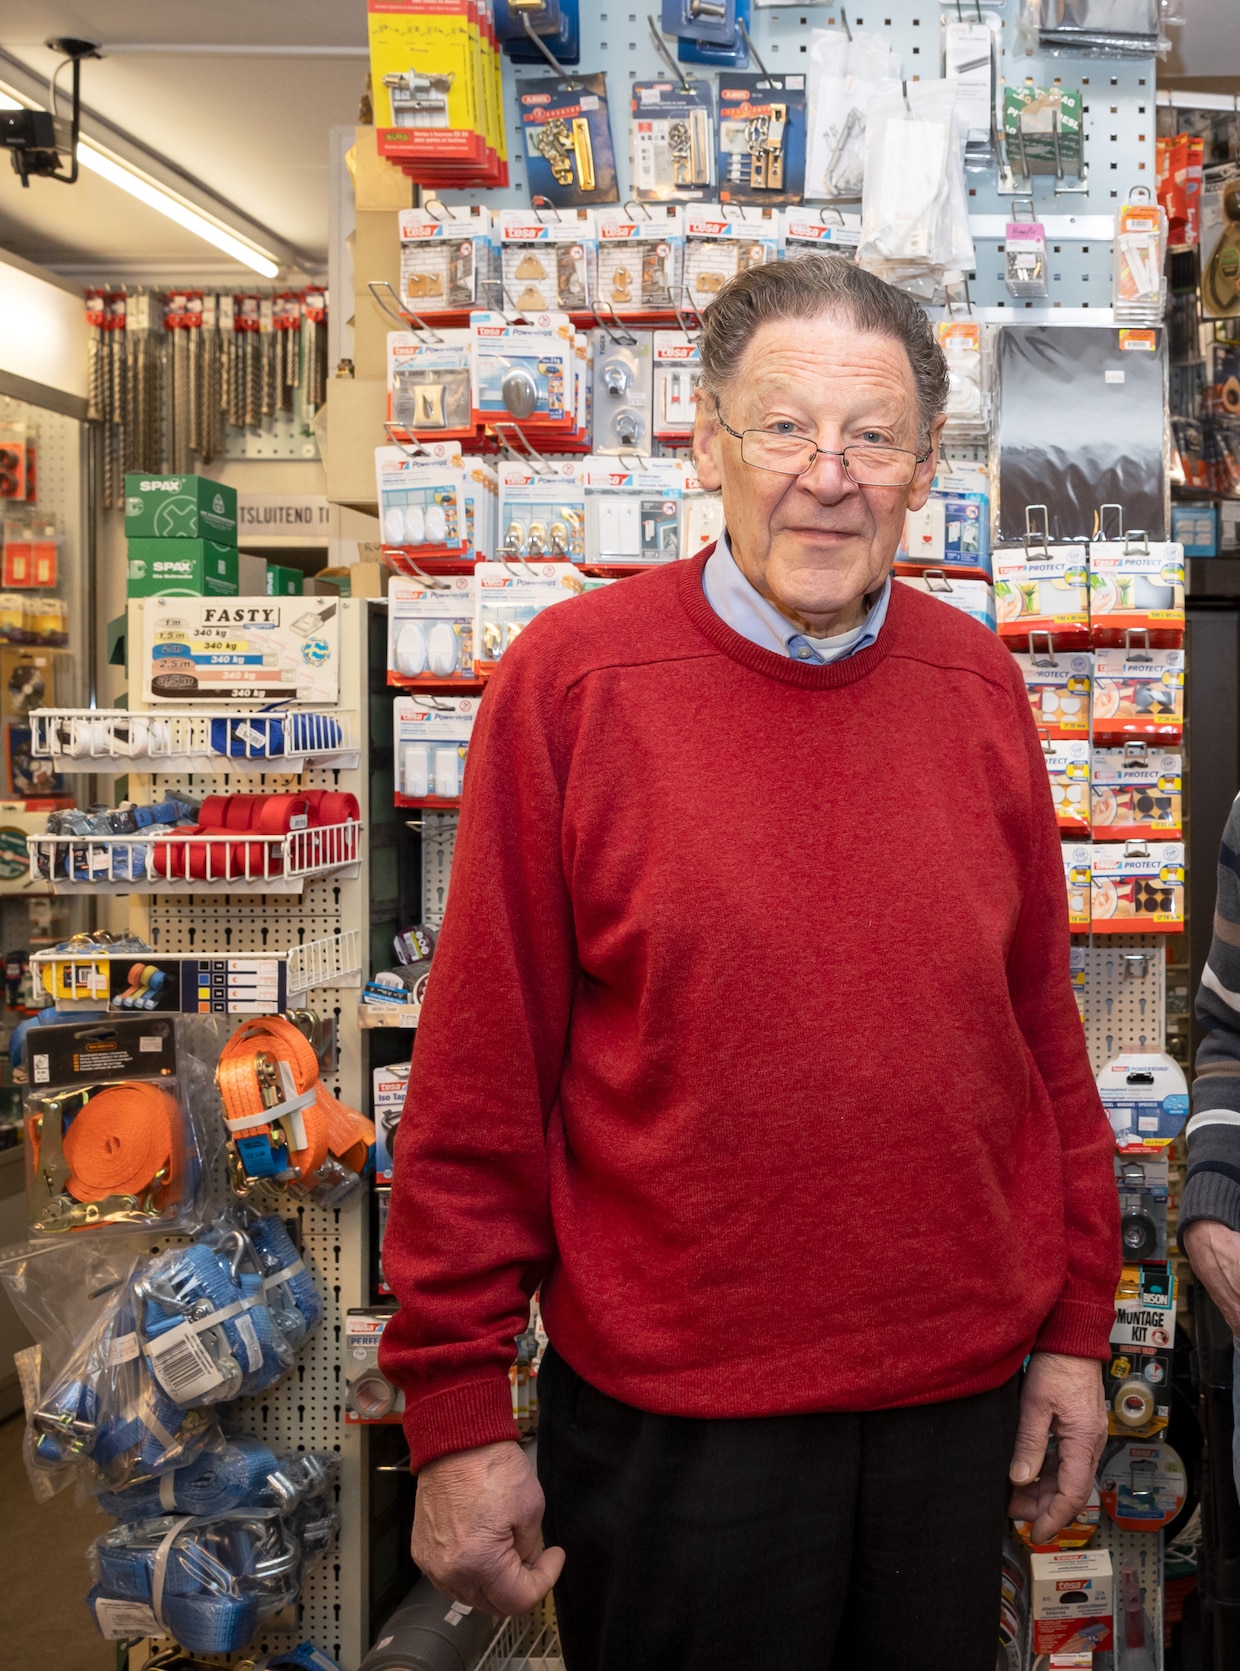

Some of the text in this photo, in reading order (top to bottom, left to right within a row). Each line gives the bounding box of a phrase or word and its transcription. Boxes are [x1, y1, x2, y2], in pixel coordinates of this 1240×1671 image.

[405, 226, 431, 238] tesa
[507, 227, 537, 238] tesa
[605, 226, 630, 237] tesa
[694, 223, 720, 235] tesa
[792, 225, 820, 238] tesa
[662, 349, 689, 358] tesa
[139, 480, 180, 492] SPAX
[152, 561, 192, 573] SPAX
[1029, 563, 1066, 572] PROTECT
[1125, 559, 1162, 567] PROTECT
[204, 608, 275, 623] FASTY
[216, 629, 227, 638] kg
[204, 642, 237, 651] 340 kg
[211, 655, 245, 665] 340 kg
[1128, 665, 1165, 673] PROTECT
[222, 671, 256, 681] 340 kg
[231, 689, 265, 698] 340 kg
[1124, 861, 1162, 869] PROTECT
[393, 1093, 406, 1101] Tap
[1143, 1293, 1168, 1305] BISON
[1117, 1308, 1165, 1328] MONTAGE
[1131, 1325, 1149, 1342] KIT
[351, 1337, 379, 1345] PERFE
[1058, 1581, 1081, 1590] tesa
